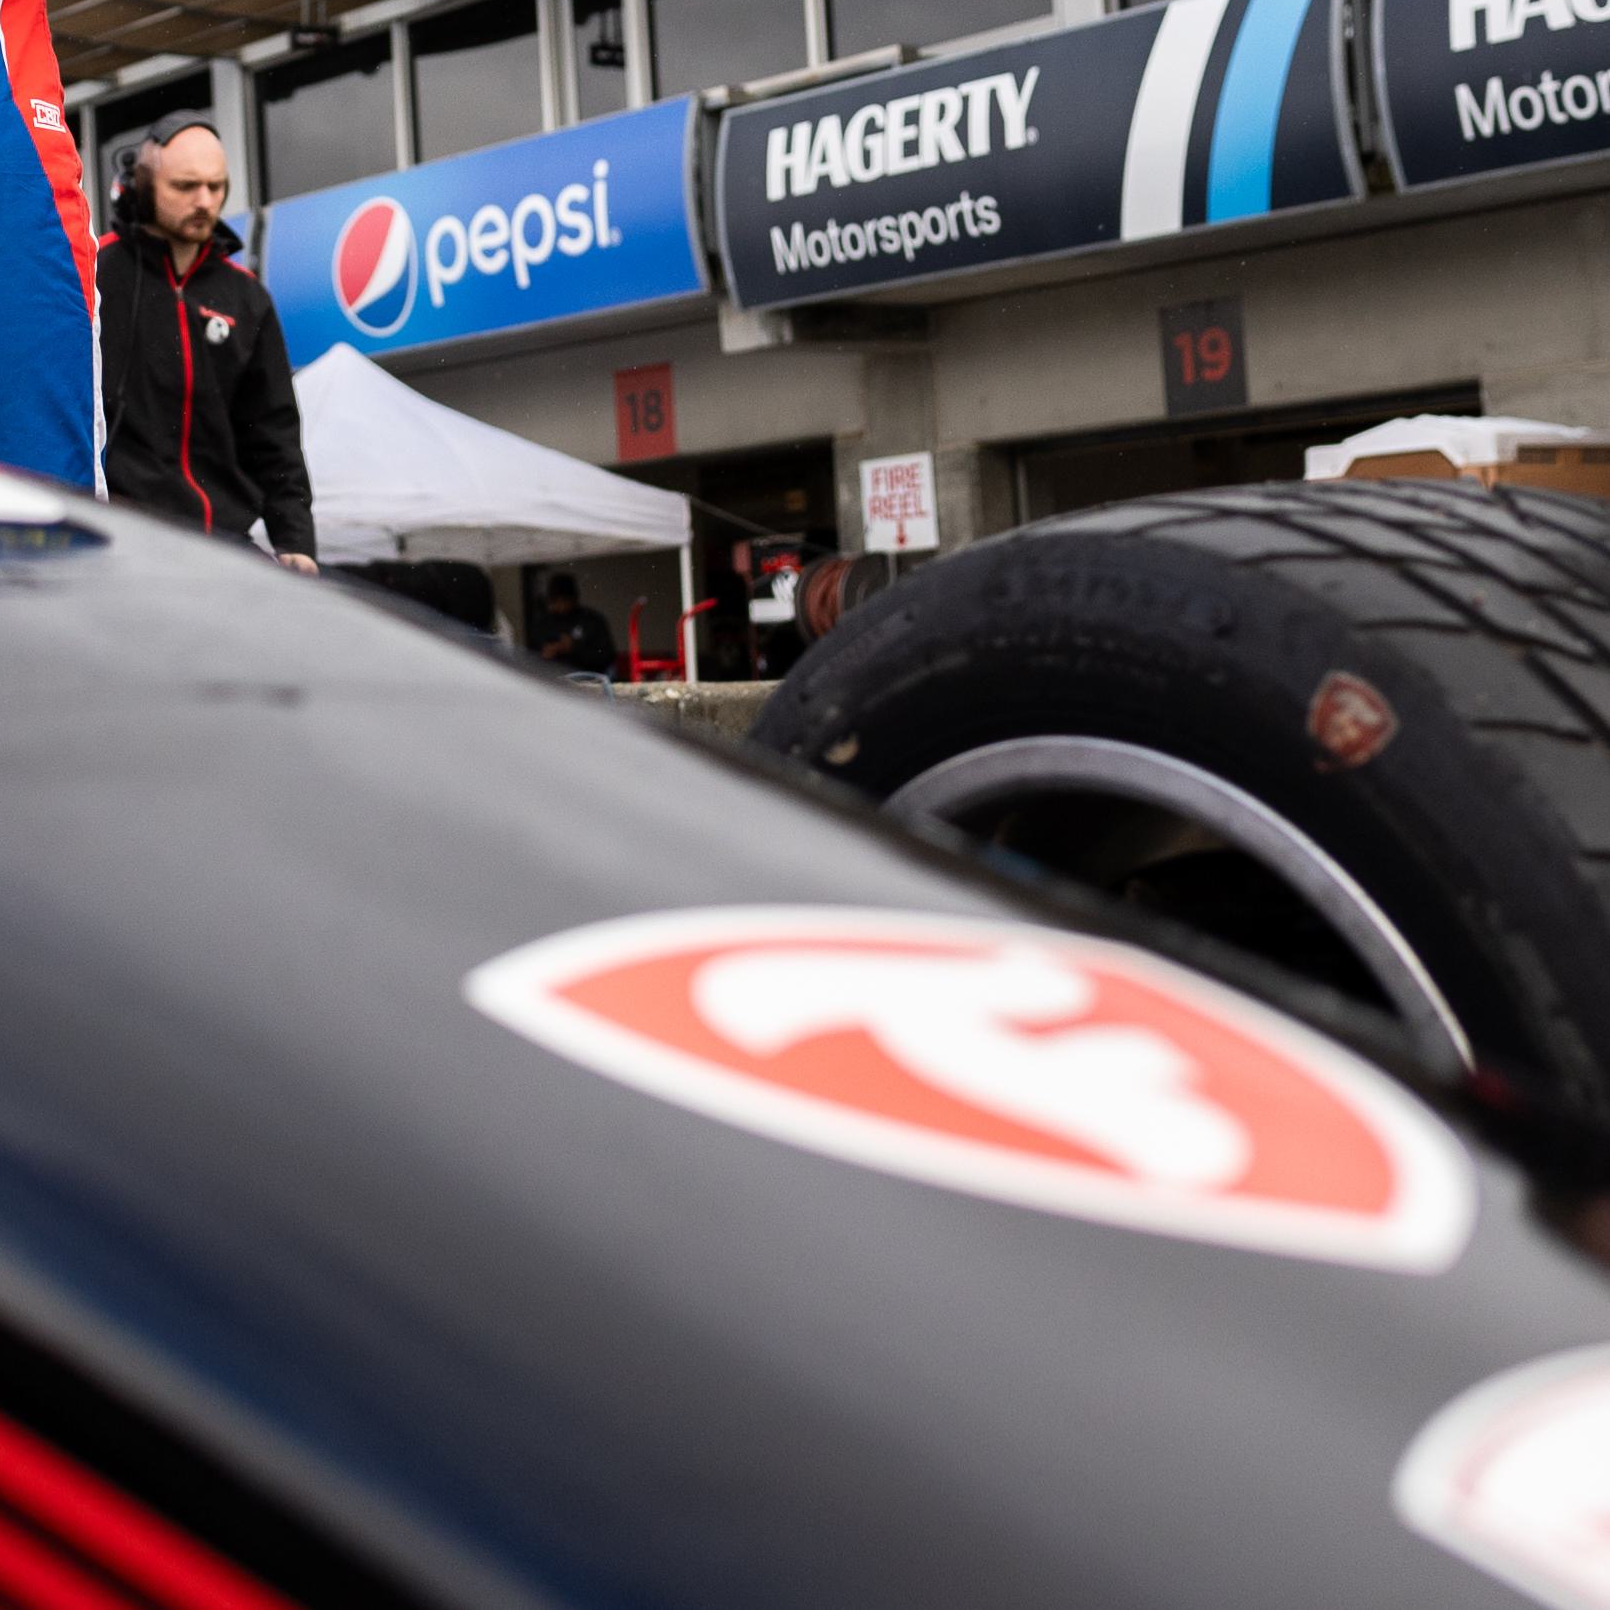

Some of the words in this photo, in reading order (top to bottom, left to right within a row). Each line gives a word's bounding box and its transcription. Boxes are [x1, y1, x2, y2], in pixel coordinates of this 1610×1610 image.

[765, 65, 1040, 202] HAGERTY
[1454, 69, 1610, 141] Motor
[425, 158, 610, 308] pepsi
[769, 190, 1002, 275] Motorsports
[1172, 325, 1233, 387] 19
[625, 389, 665, 434] 18
[869, 492, 928, 520] REEL
[870, 461, 922, 490] FIRE
